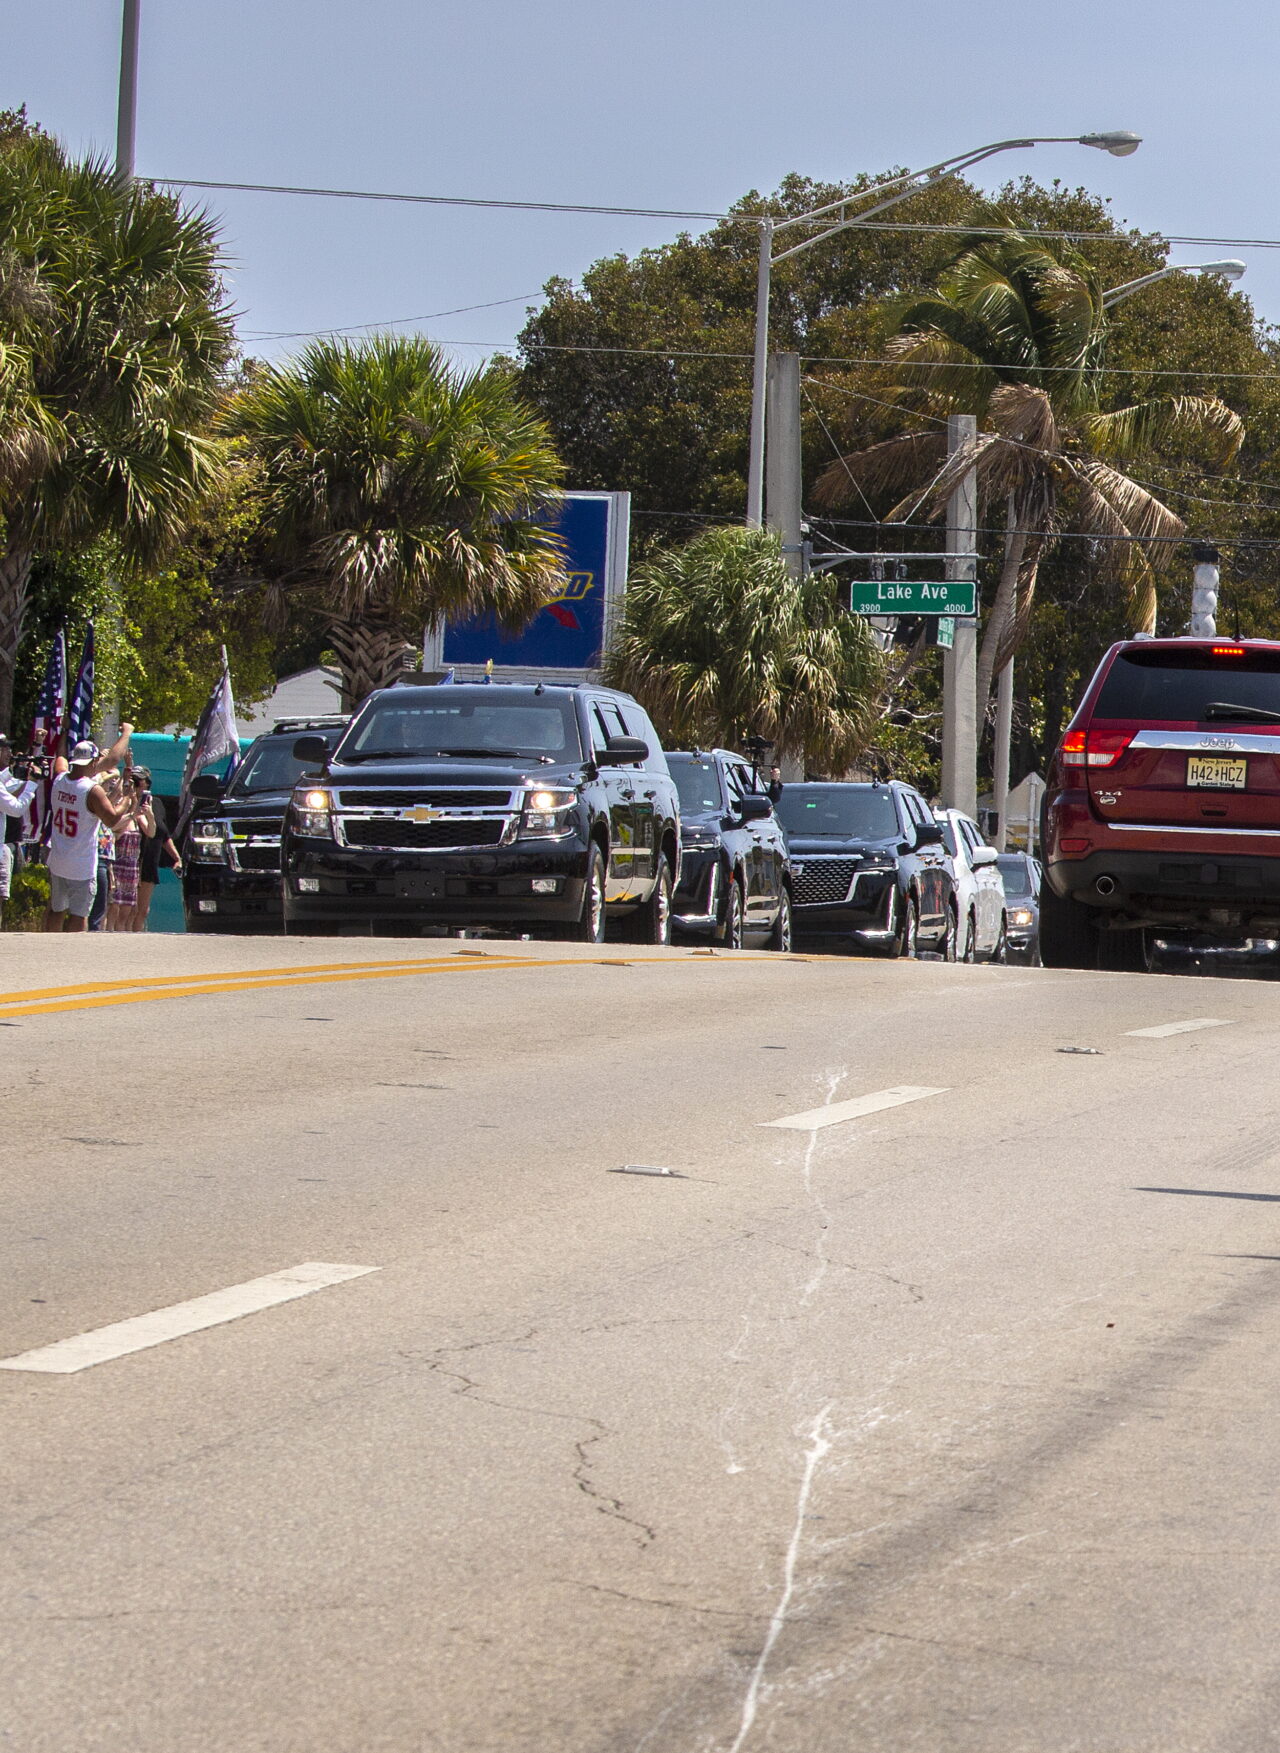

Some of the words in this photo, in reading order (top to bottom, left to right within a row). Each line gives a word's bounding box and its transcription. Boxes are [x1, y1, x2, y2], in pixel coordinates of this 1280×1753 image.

[877, 583, 912, 599] Lake
[921, 583, 948, 599] Ave
[860, 604, 881, 612] 3900
[944, 604, 966, 612] 4000
[1200, 736, 1235, 750] Jeep
[54, 807, 79, 838] 45
